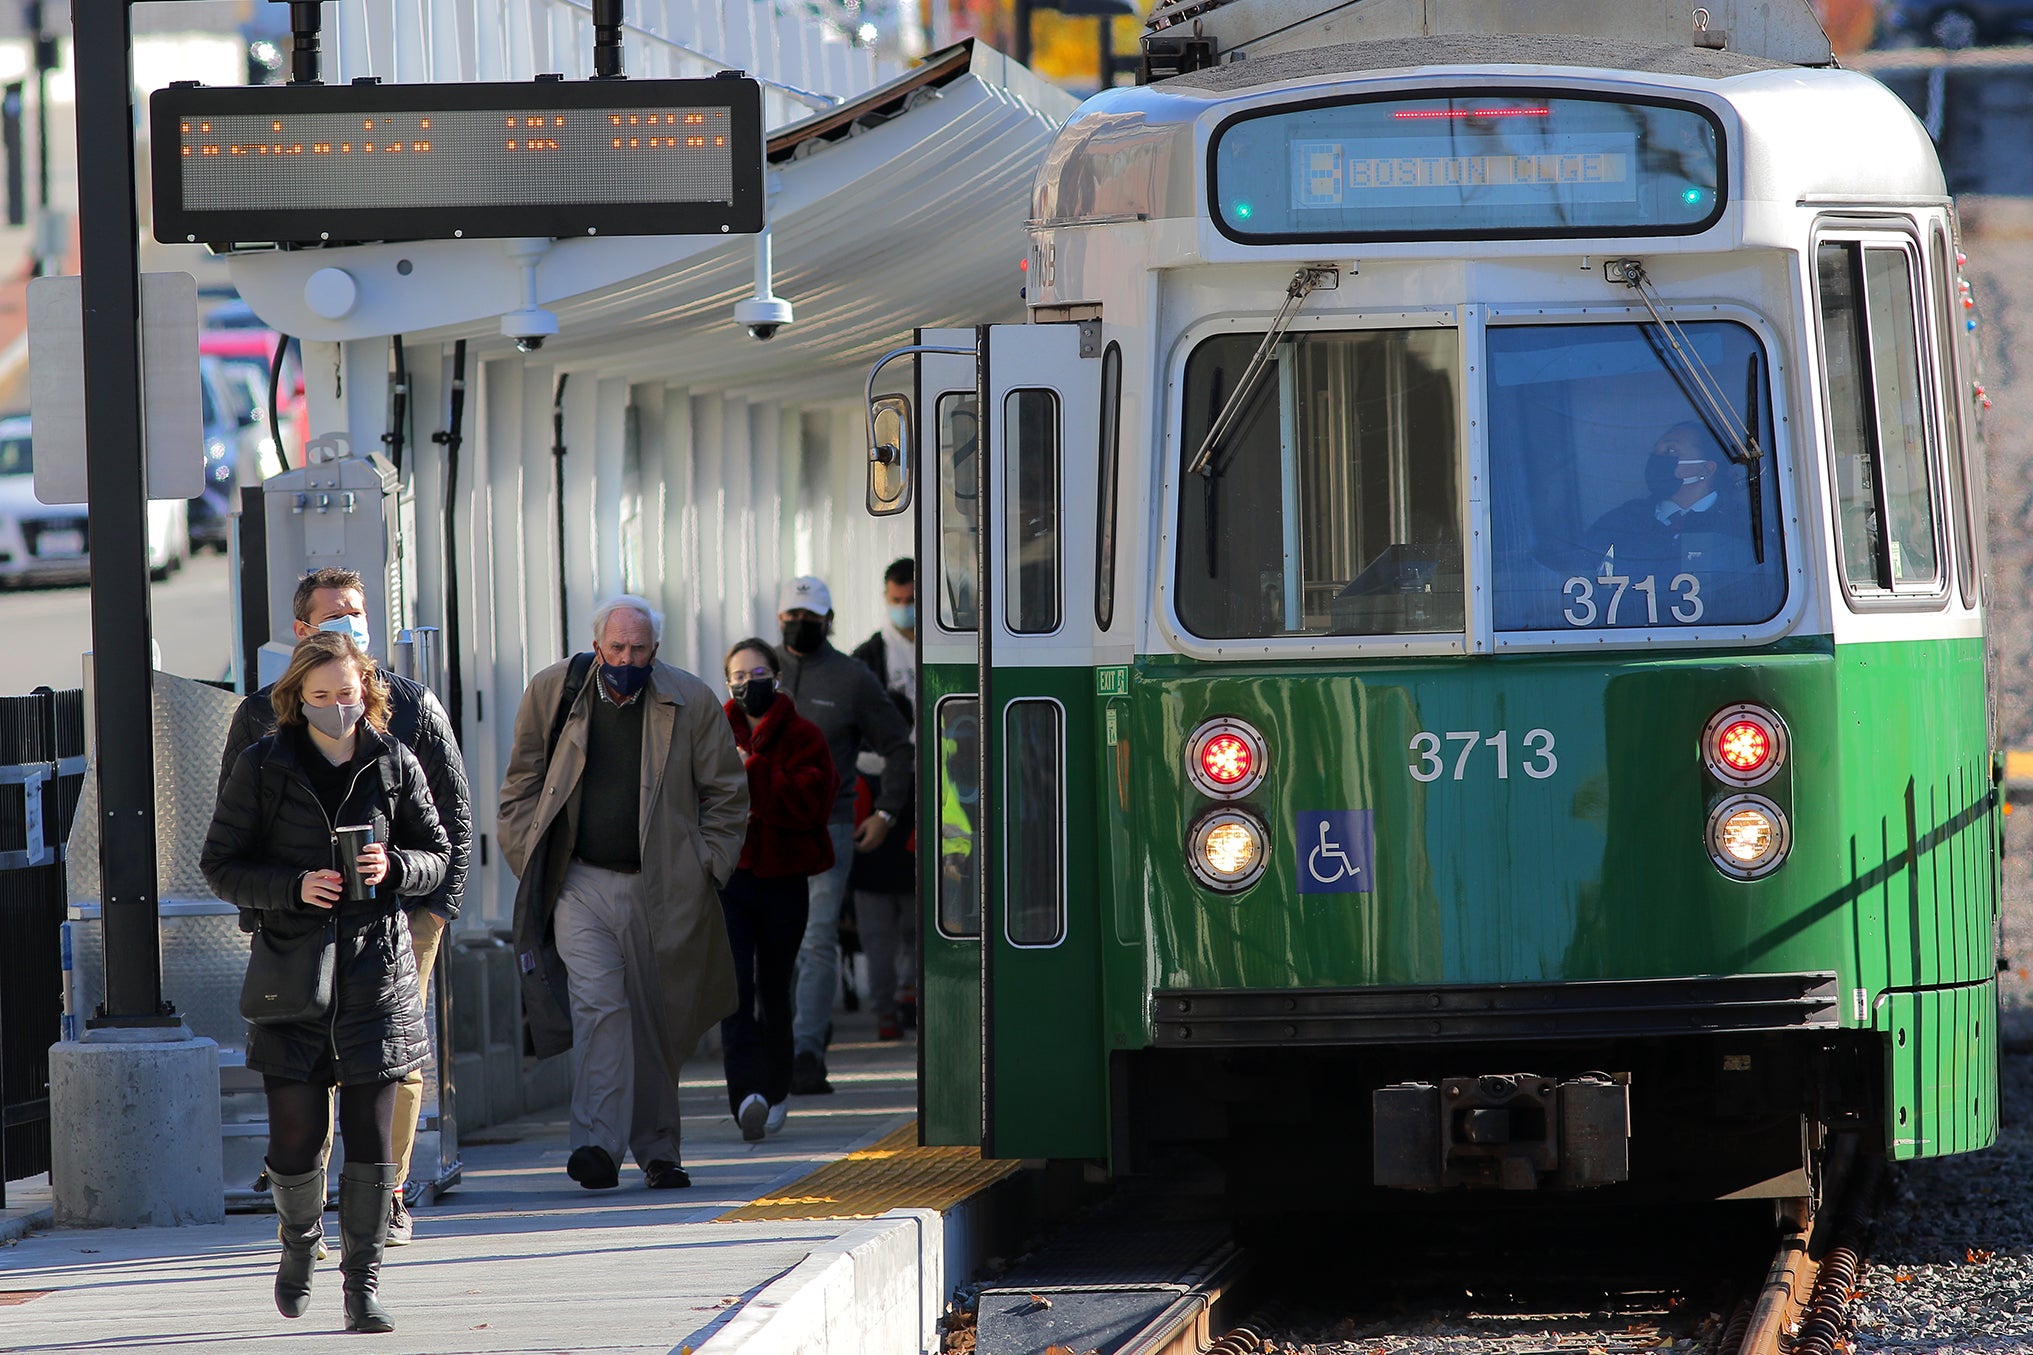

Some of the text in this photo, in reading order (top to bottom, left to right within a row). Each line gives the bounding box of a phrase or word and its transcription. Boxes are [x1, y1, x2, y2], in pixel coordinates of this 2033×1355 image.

[1303, 145, 1601, 203] B BOSTON CLGE
[1563, 573, 1704, 627] 3713
[1100, 670, 1115, 691] EXIT
[1408, 728, 1559, 783] 3713
